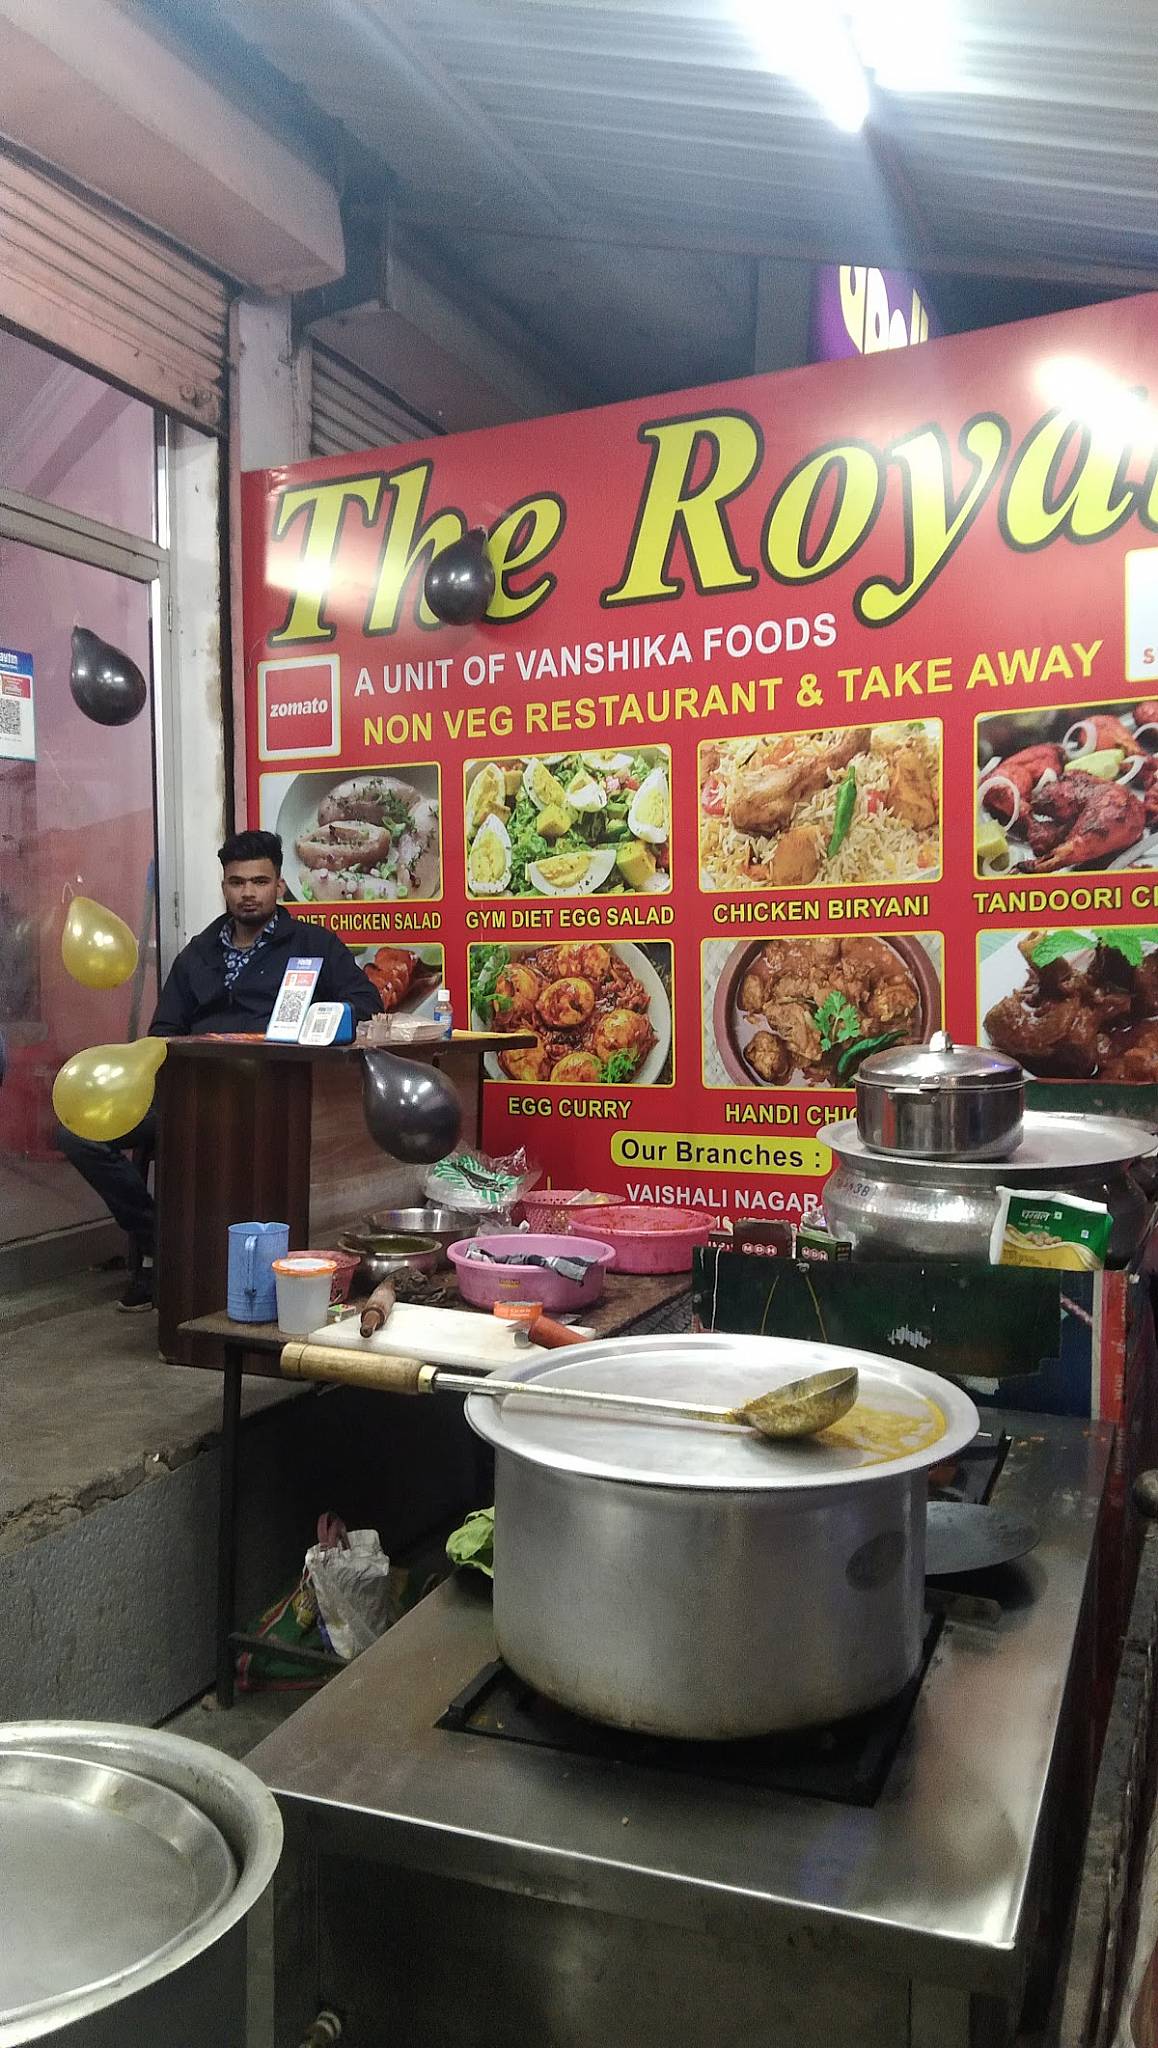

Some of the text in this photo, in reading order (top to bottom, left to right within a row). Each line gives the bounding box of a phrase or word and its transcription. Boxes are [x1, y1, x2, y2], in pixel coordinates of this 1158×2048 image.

[267, 386, 1158, 648] The Roya
[354, 612, 837, 697] A UNIT OF VANSHIKA FOODS
[364, 639, 1103, 747] NON VEG RESTAURANT & TAKE AWAY
[269, 697, 329, 718] zomato
[713, 896, 929, 924] CHICKEN BIRYANI
[972, 885, 1158, 914] TANDOORI C
[330, 913, 391, 930] CHICKEN
[394, 912, 442, 930] SALAD
[465, 905, 674, 931] GYM DIET EGG SALAD
[508, 1096, 632, 1120] EGG CURRY
[725, 1103, 857, 1126] HANDI CHI
[621, 1138, 668, 1162] Our
[676, 1141, 803, 1168] Branches
[626, 1183, 819, 1212] VAISHALI NAGAR
[742, 1242, 777, 1258] MDH
[802, 1246, 828, 1262] MDH
